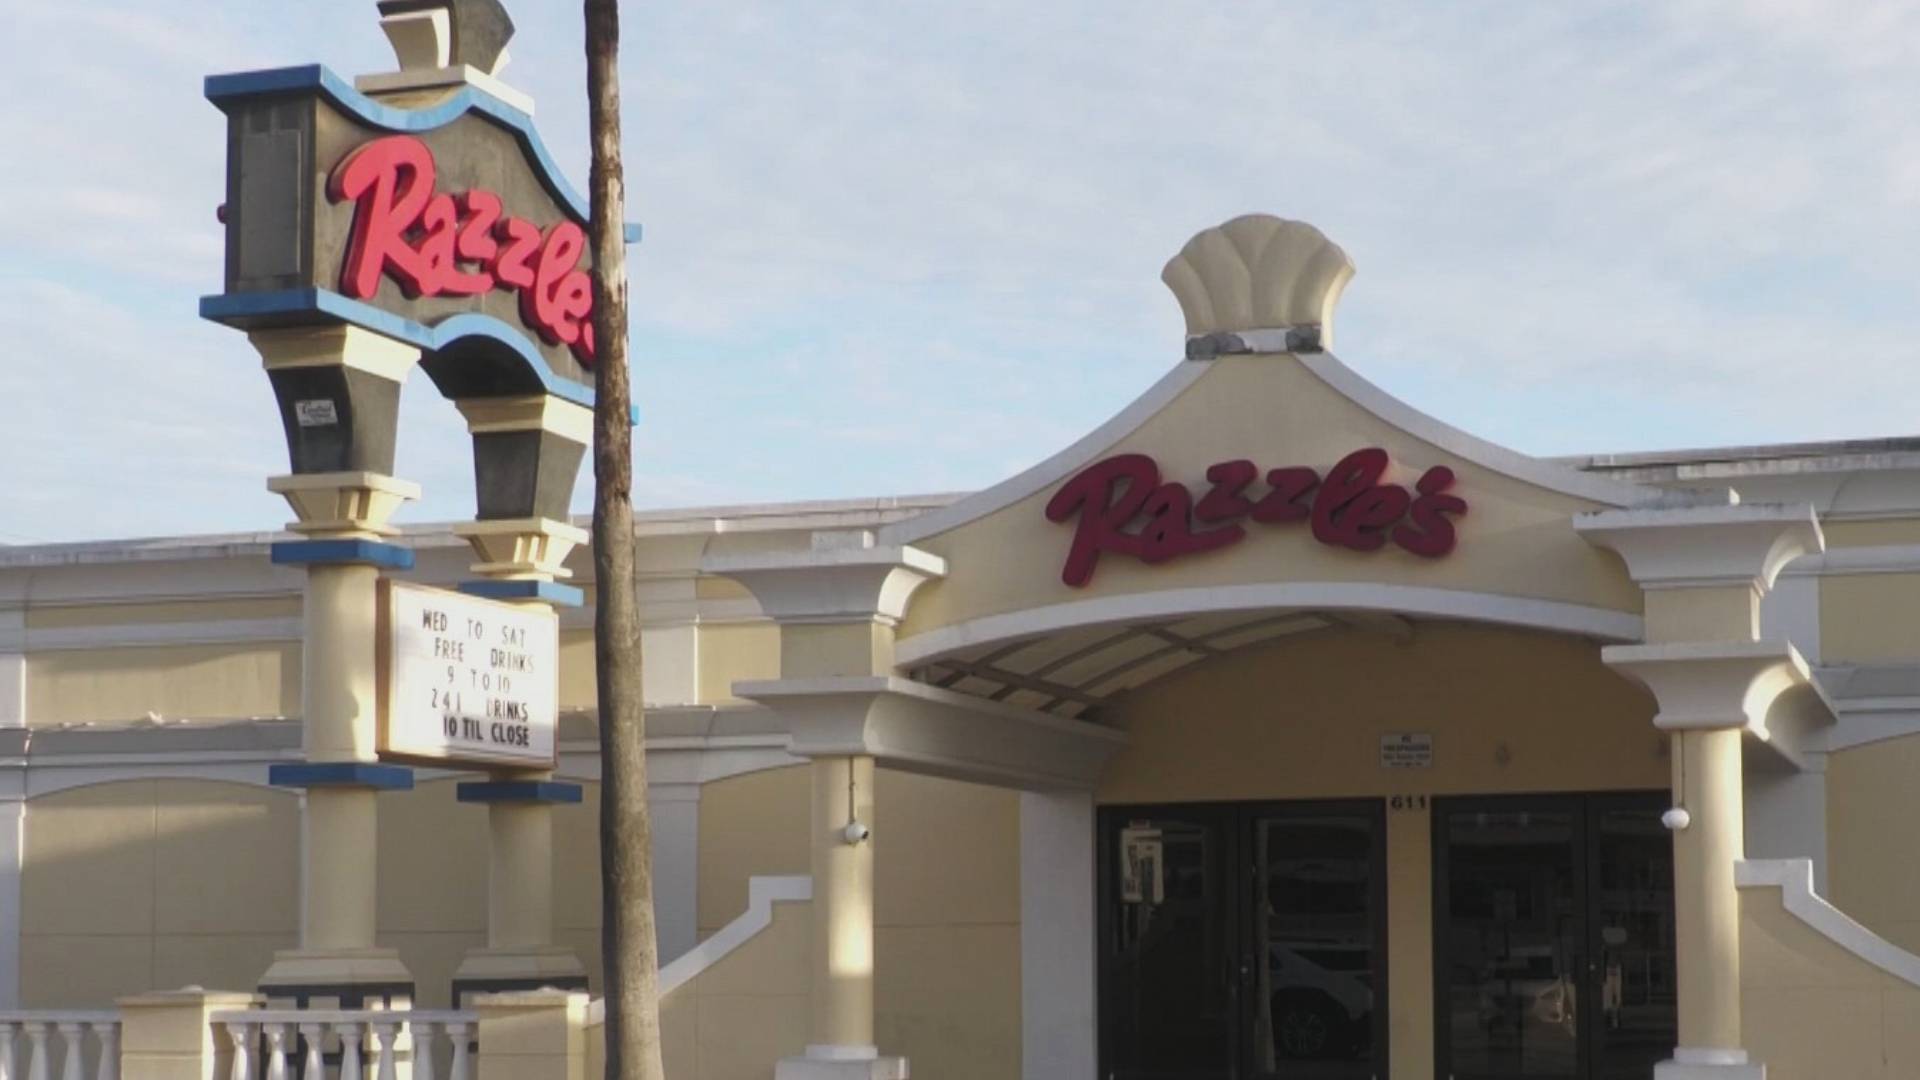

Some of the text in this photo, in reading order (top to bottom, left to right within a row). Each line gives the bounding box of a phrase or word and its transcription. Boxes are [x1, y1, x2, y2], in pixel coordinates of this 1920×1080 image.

[1045, 447, 1468, 587] Razzle's
[422, 609, 525, 648] WED TO SAT
[434, 637, 534, 673] FREE DRINKS
[447, 666, 455, 684] 9
[463, 717, 484, 740] TIL
[491, 722, 530, 748] CLOSE
[1391, 795, 1426, 809] 611
